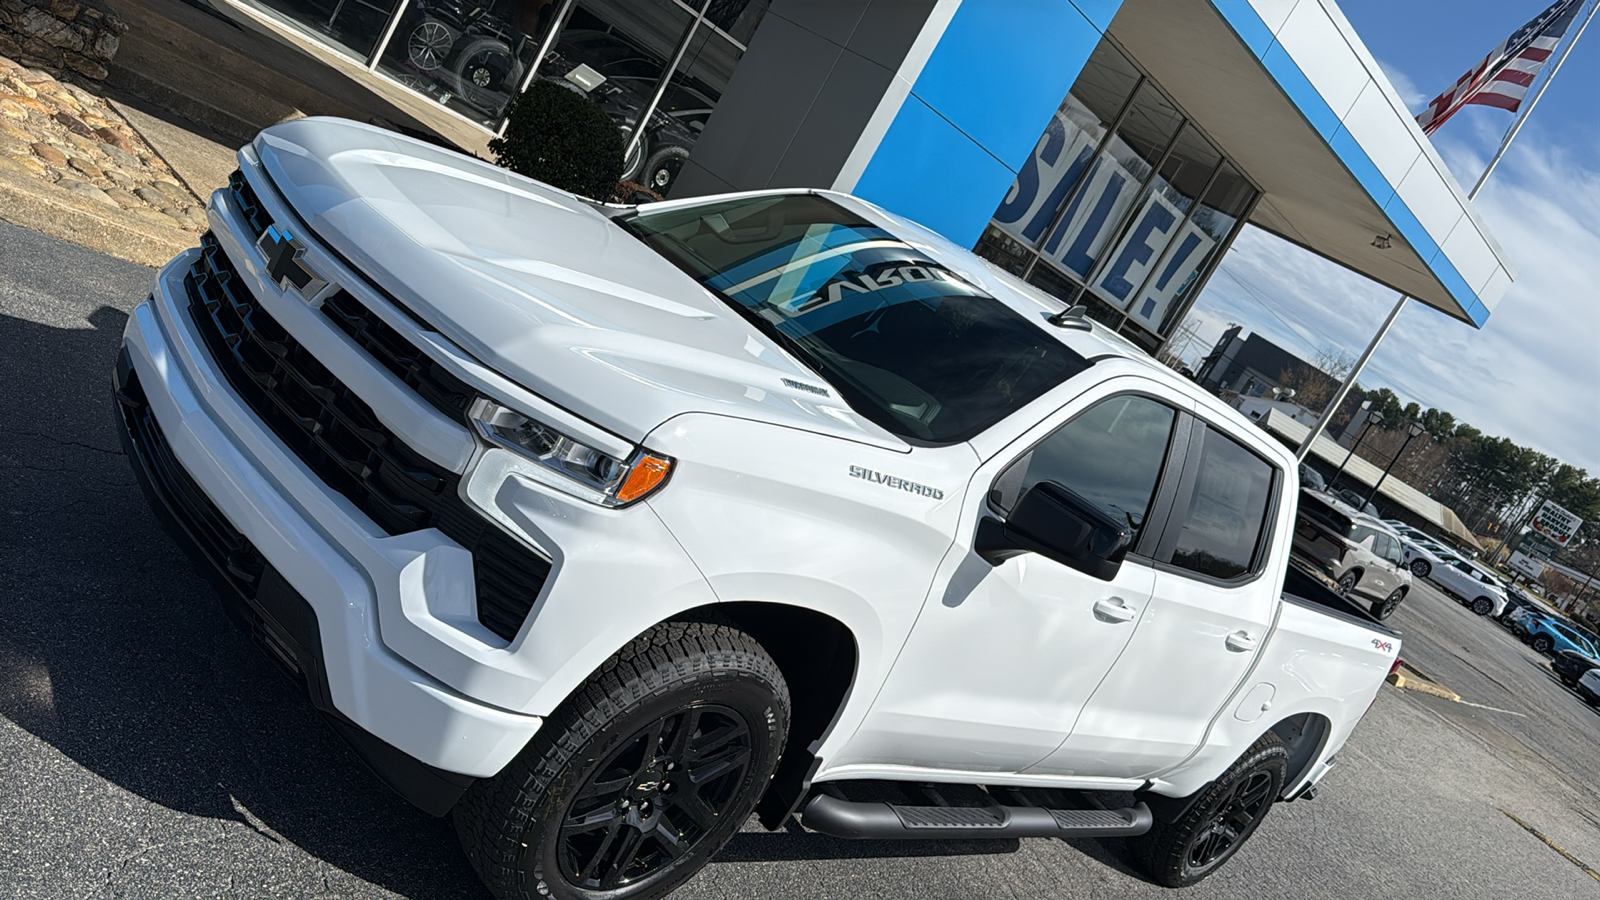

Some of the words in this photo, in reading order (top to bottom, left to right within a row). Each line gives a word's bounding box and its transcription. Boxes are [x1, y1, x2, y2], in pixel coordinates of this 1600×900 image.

[992, 114, 1202, 320] SALE!
[848, 464, 945, 501] SILVERADO
[1541, 505, 1572, 525] HEALTHY
[1541, 512, 1572, 532] HARVEST
[1540, 518, 1571, 539] PRODUCE
